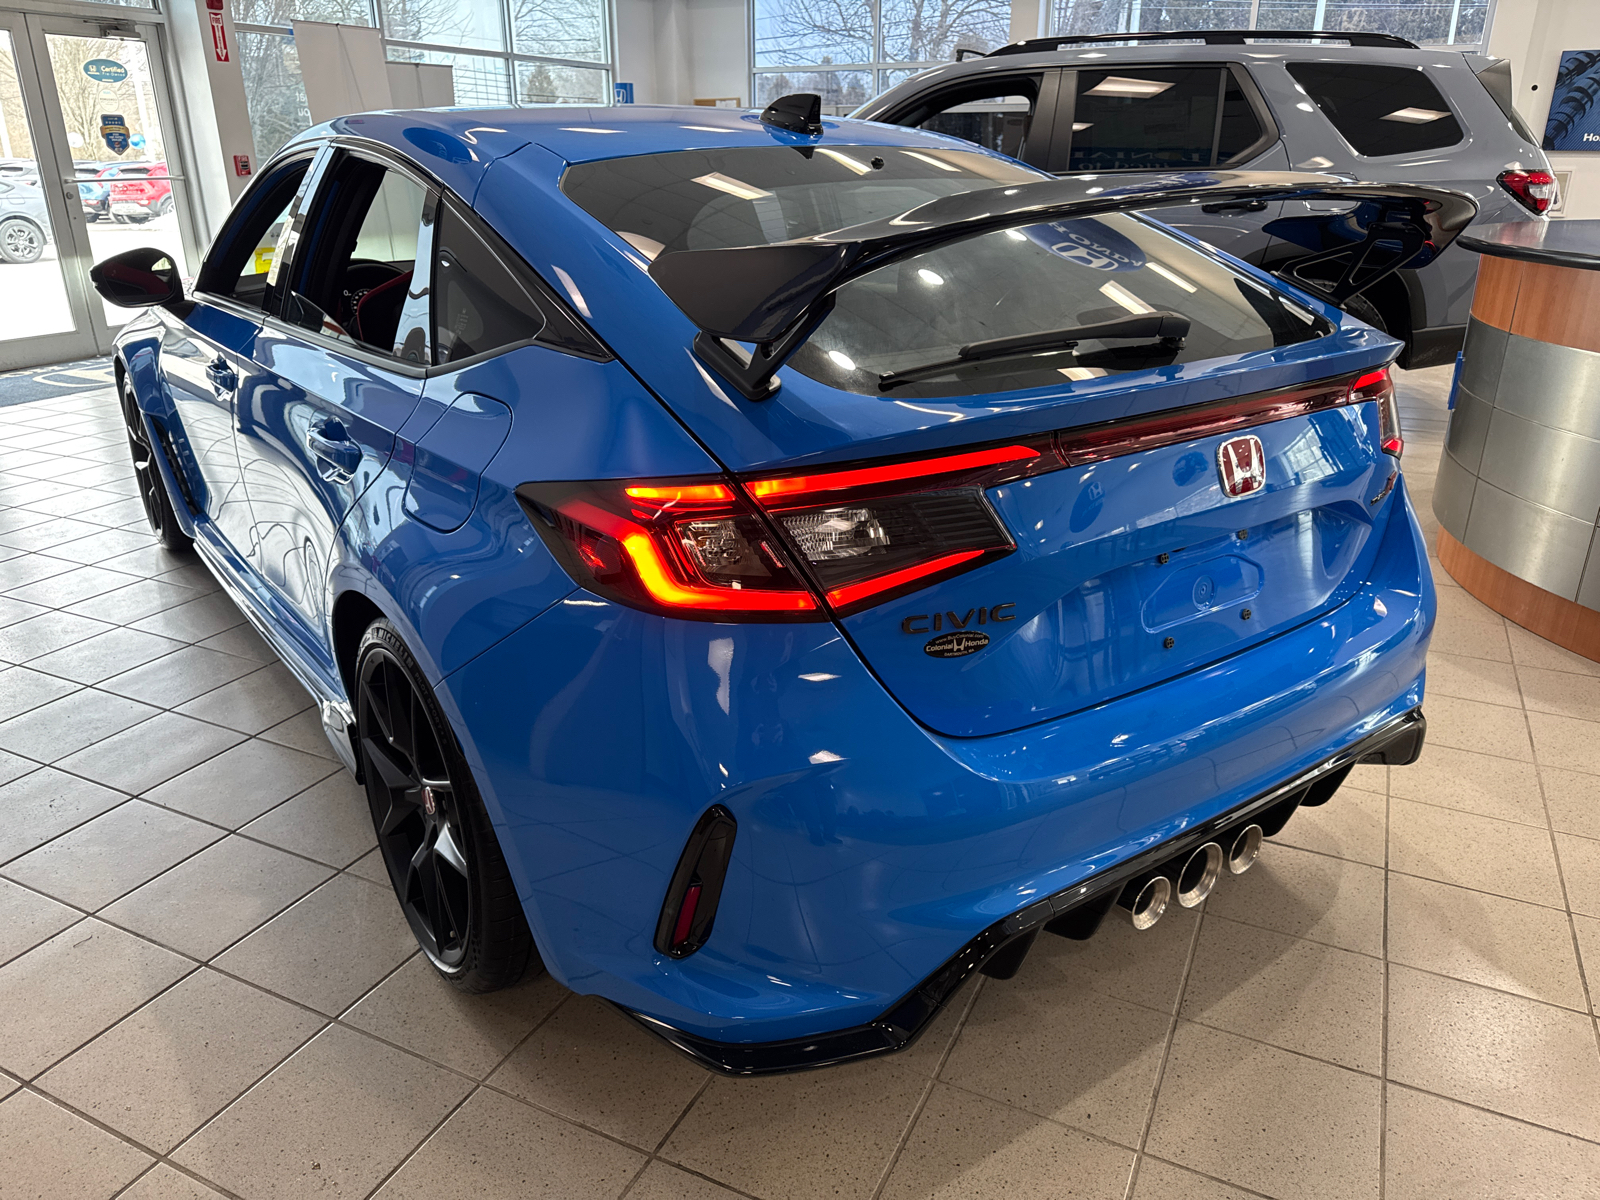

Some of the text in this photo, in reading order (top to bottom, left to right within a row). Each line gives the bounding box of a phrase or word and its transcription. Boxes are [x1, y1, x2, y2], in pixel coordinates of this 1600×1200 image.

[101, 65, 125, 73] Certified
[1583, 133, 1600, 142] Ho
[901, 602, 1016, 634] CIVIC
[377, 627, 415, 669] MICHELIN
[926, 643, 953, 652] Colonial
[965, 638, 989, 647] Honda
[414, 671, 428, 696] PILOT
[427, 697, 443, 732] SPORT
